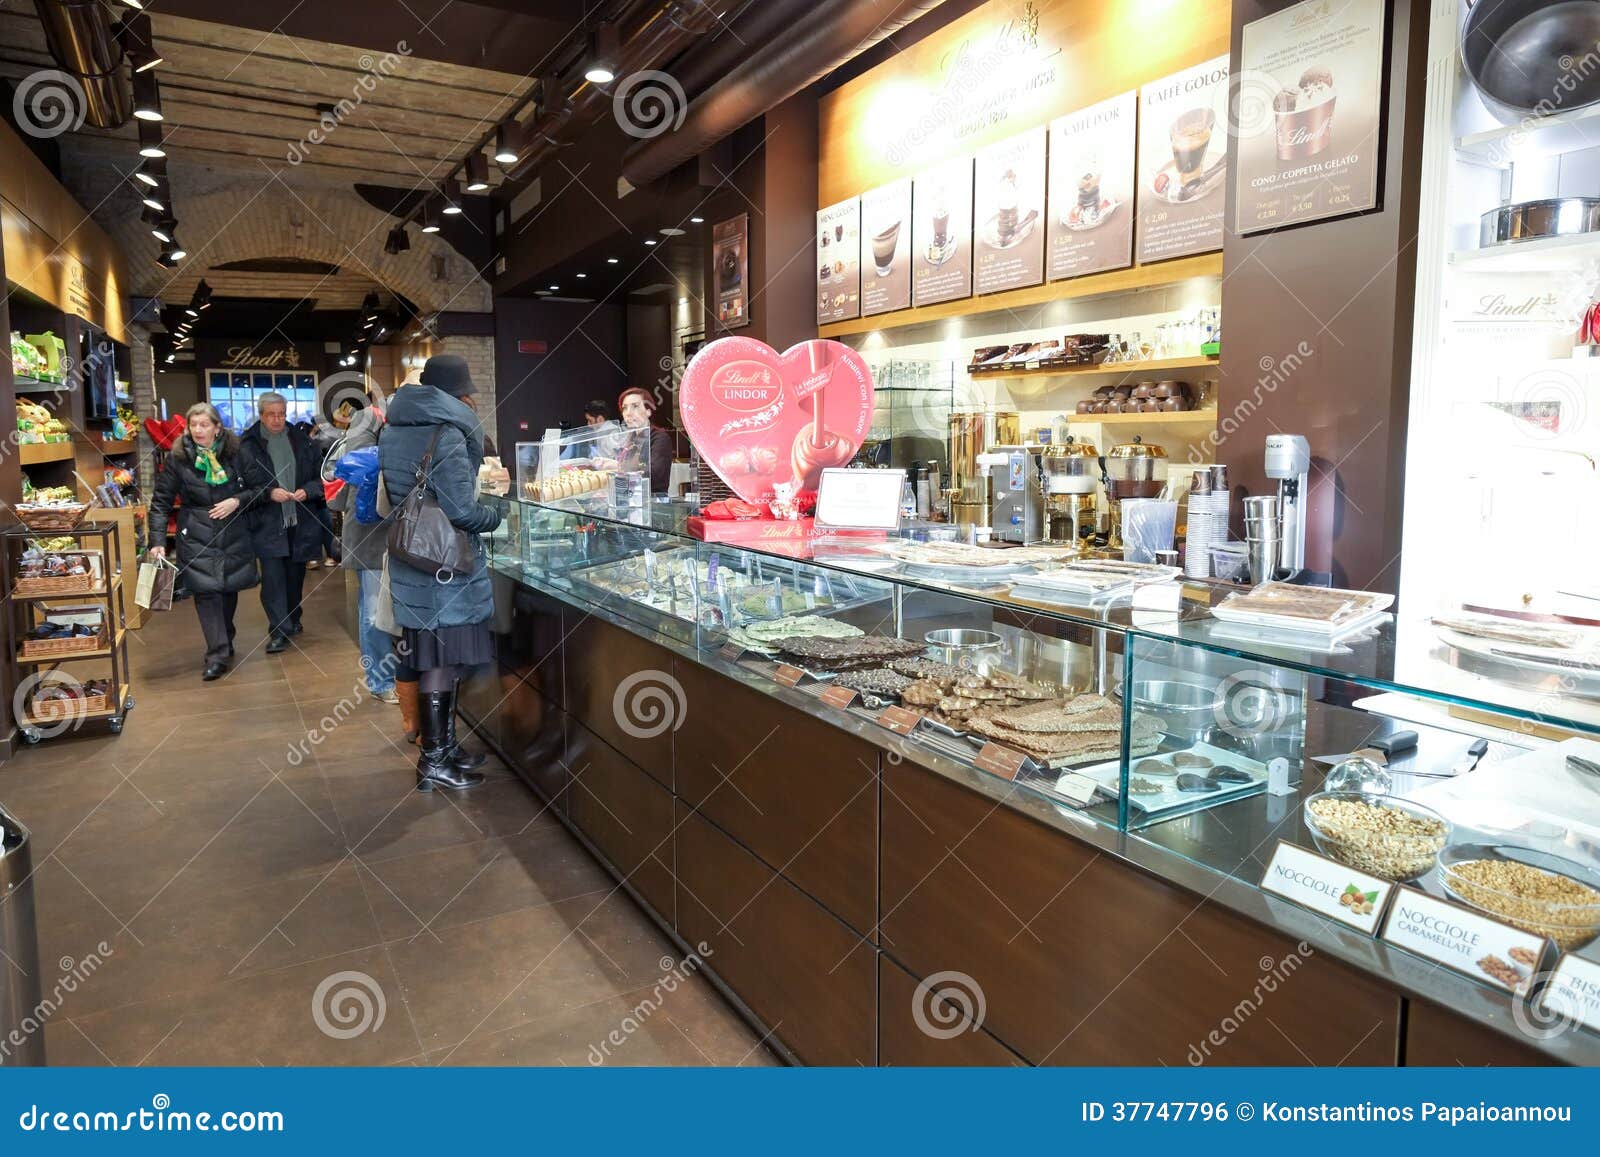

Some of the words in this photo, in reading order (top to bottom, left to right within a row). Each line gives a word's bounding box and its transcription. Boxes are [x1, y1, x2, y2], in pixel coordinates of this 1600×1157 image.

[1250, 174, 1276, 188] CONO
[1282, 162, 1323, 181] COPPETTA
[1324, 154, 1359, 170] GELATO
[1472, 294, 1541, 316] Lindt
[220, 345, 285, 367] Lindt
[722, 369, 763, 384] Lindt
[723, 389, 768, 400] LINDOR
[1274, 863, 1339, 899] NOCCIOLE
[1397, 920, 1475, 957] CARAMELLATE
[1399, 906, 1481, 946] NOCCIOLE
